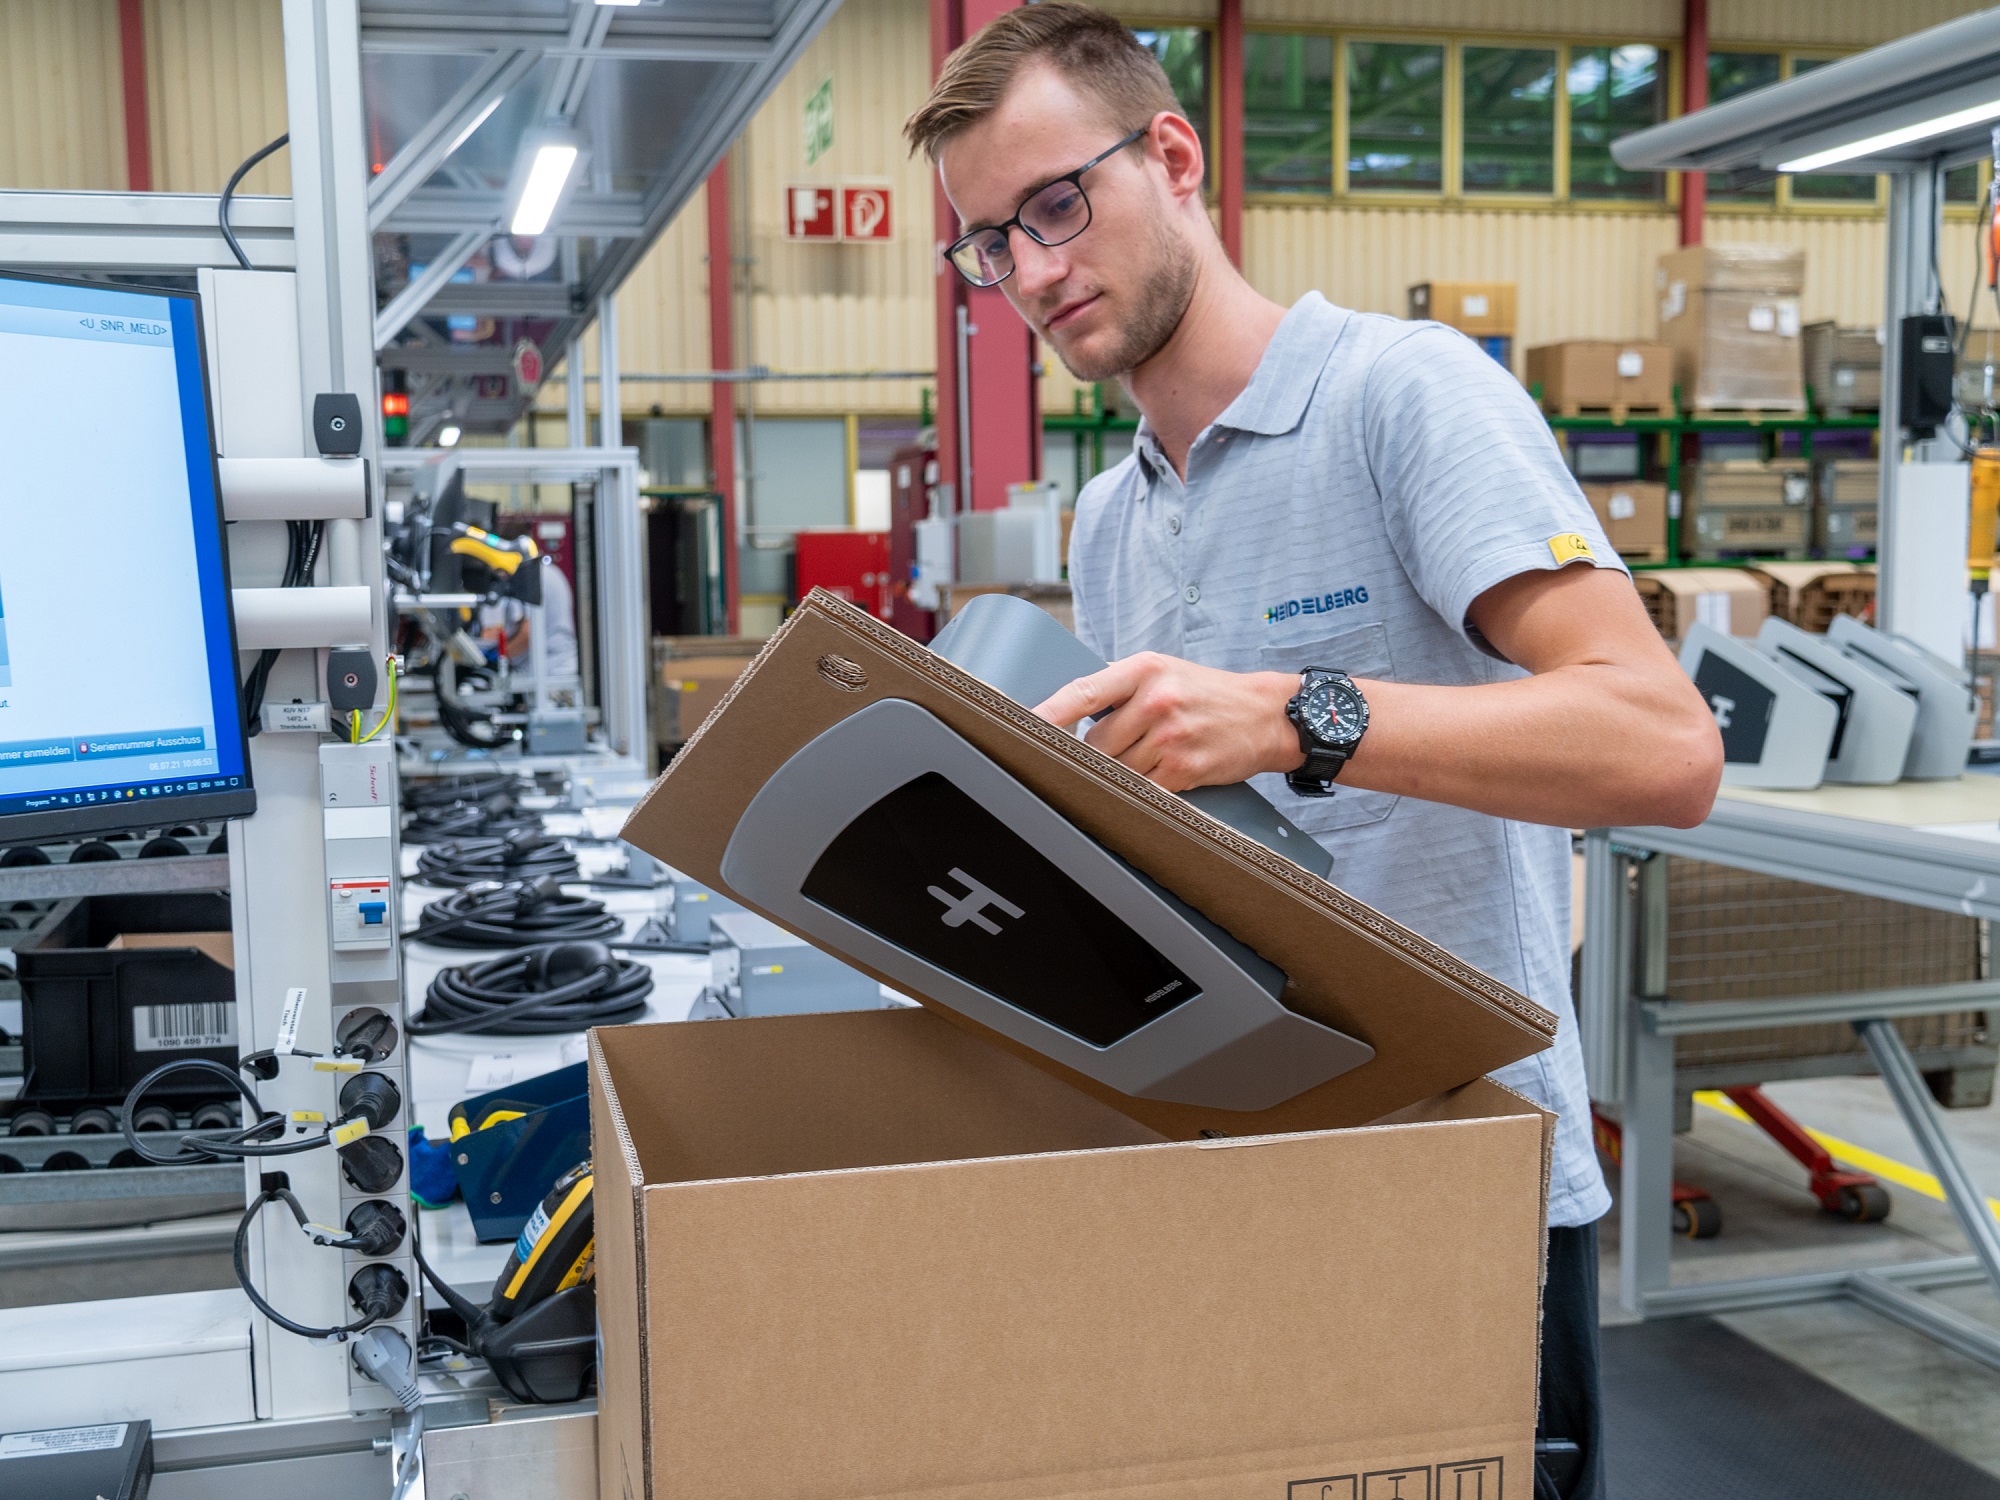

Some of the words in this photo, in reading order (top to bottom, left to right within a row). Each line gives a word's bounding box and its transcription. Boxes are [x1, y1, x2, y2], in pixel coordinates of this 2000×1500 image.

[80, 318, 167, 336] <U_SNR_MELD>
[1264, 586, 1369, 624] HEIDELBERG
[23, 746, 70, 758] anmelden
[90, 742, 155, 753] Seriennummer
[156, 736, 202, 747] Ausschuss
[1144, 979, 1183, 1004] HEIDELBERG
[205, 1036, 221, 1045] 774
